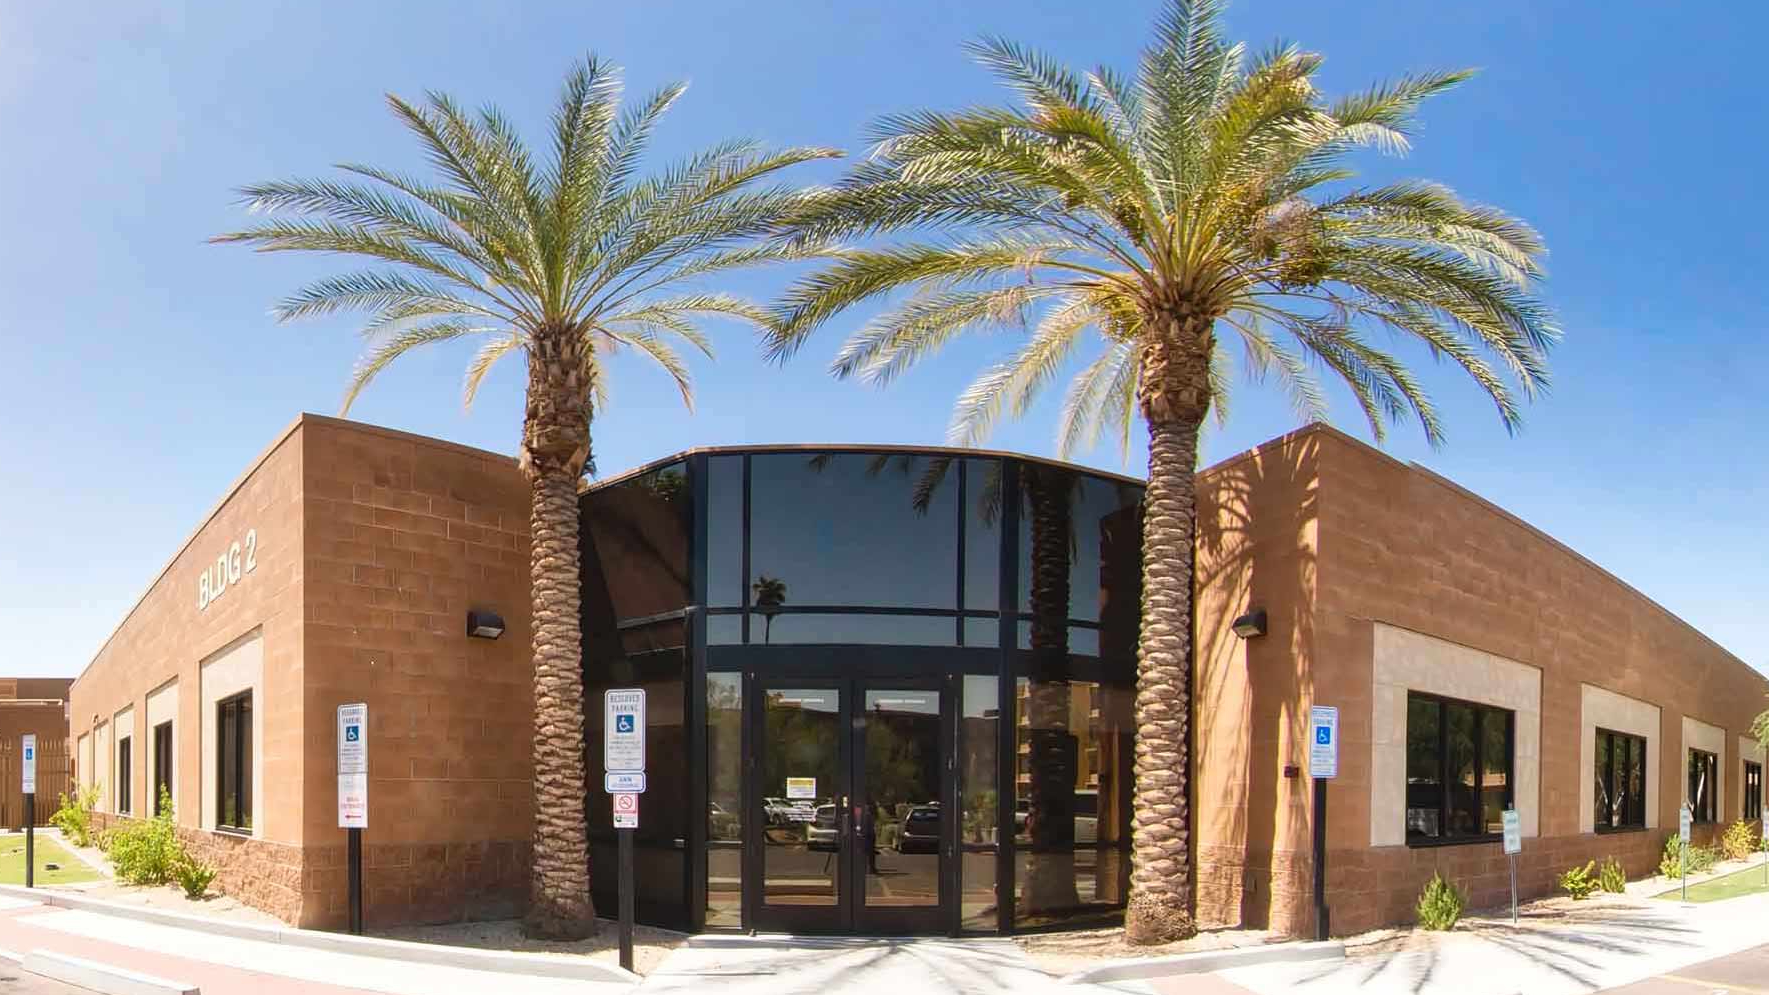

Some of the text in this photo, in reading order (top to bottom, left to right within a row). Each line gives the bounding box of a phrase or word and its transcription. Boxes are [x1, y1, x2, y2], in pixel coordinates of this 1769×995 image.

[198, 528, 257, 612] BLDG 2
[611, 704, 639, 712] PARKING
